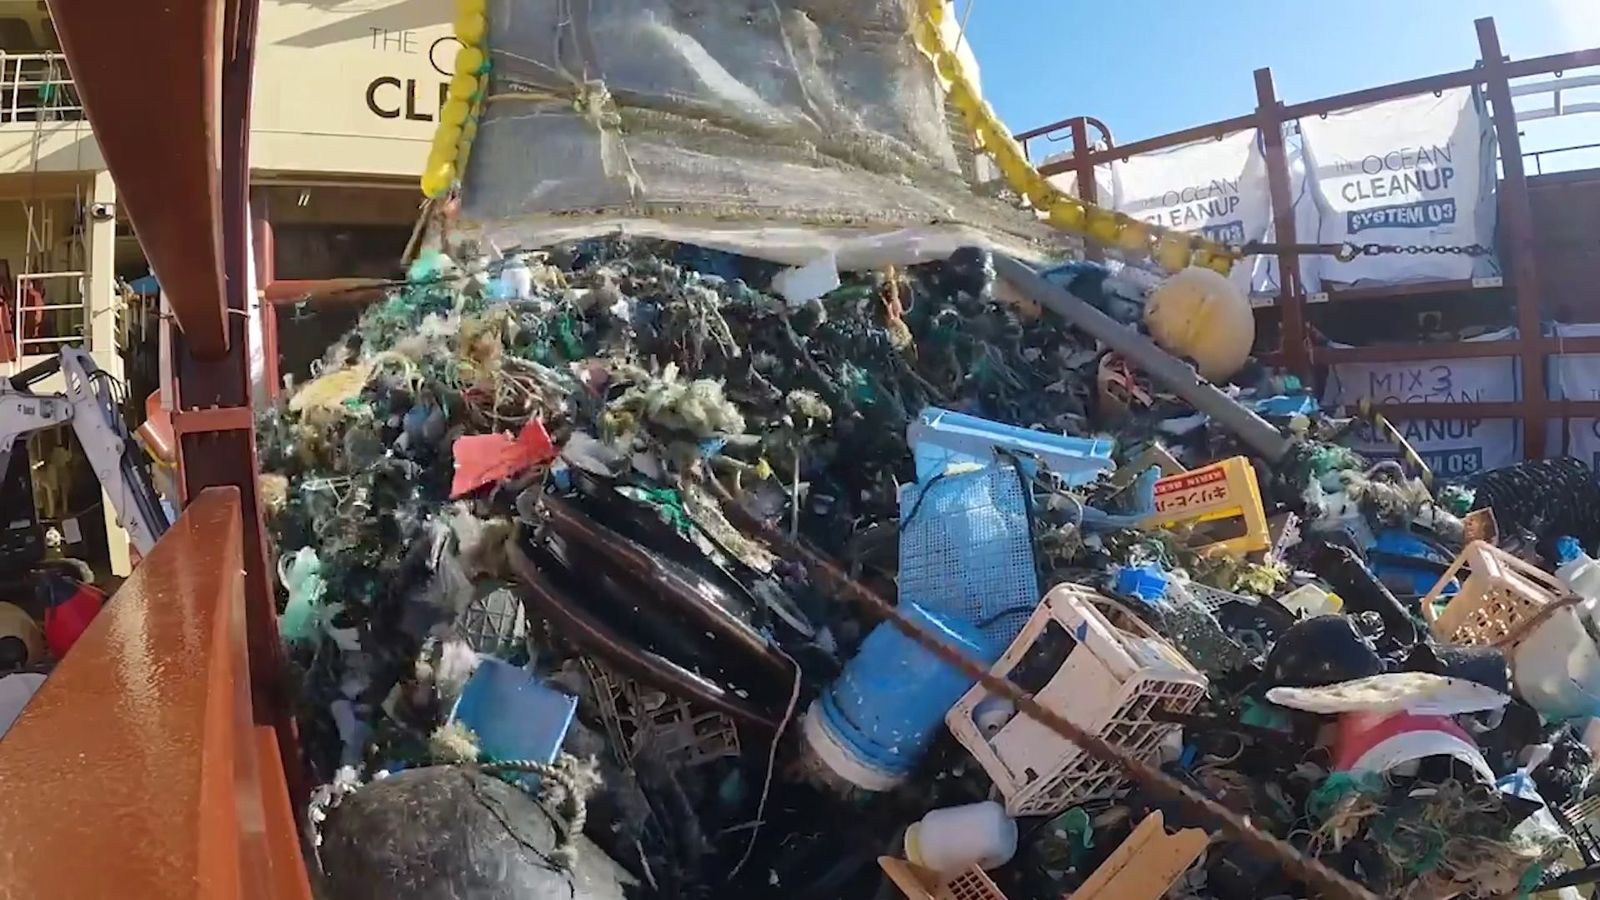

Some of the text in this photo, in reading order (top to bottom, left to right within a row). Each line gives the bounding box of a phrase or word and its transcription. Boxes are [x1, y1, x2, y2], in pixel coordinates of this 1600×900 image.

[369, 27, 418, 54] THE
[1362, 144, 1453, 175] OCEAN
[1162, 177, 1239, 208] OCEAN
[1342, 168, 1454, 203] CLEANUP
[1352, 203, 1454, 230] SYSTEM 03
[1447, 454, 1478, 472] 03
